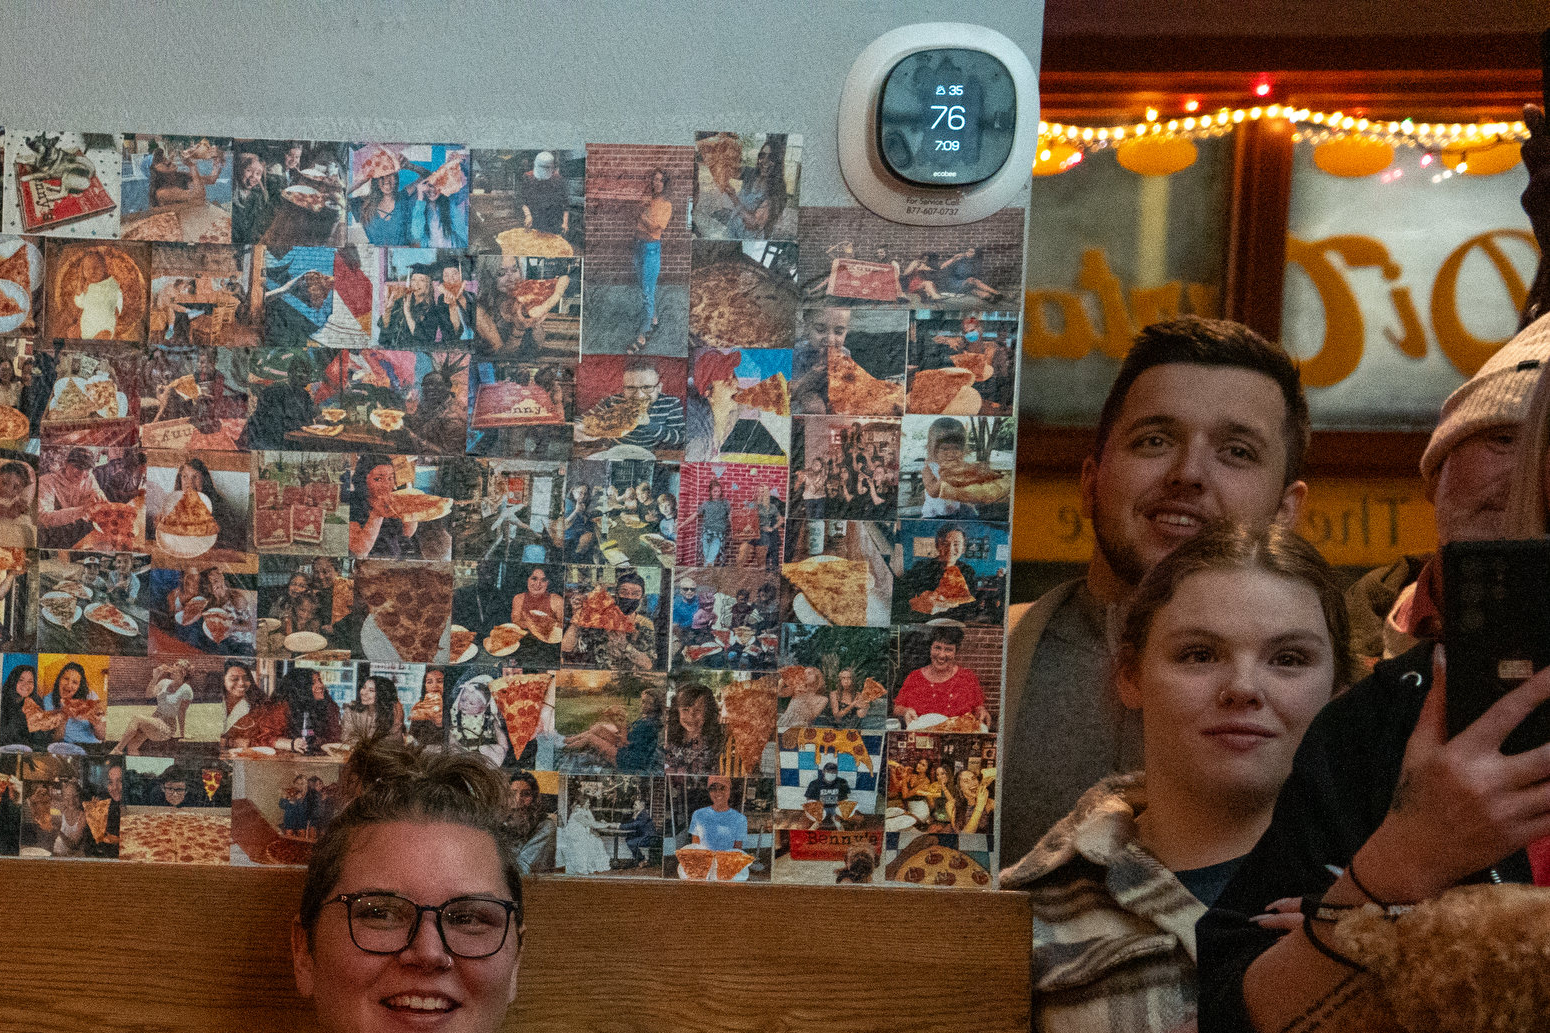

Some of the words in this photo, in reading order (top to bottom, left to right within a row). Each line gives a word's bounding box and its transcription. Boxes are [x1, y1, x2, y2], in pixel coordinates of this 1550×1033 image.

[948, 85, 964, 96] 35
[930, 105, 966, 130] 76
[935, 140, 960, 151] 7:09
[906, 197, 918, 205] For
[920, 197, 943, 205] Service
[906, 207, 959, 216] 877-607-0737
